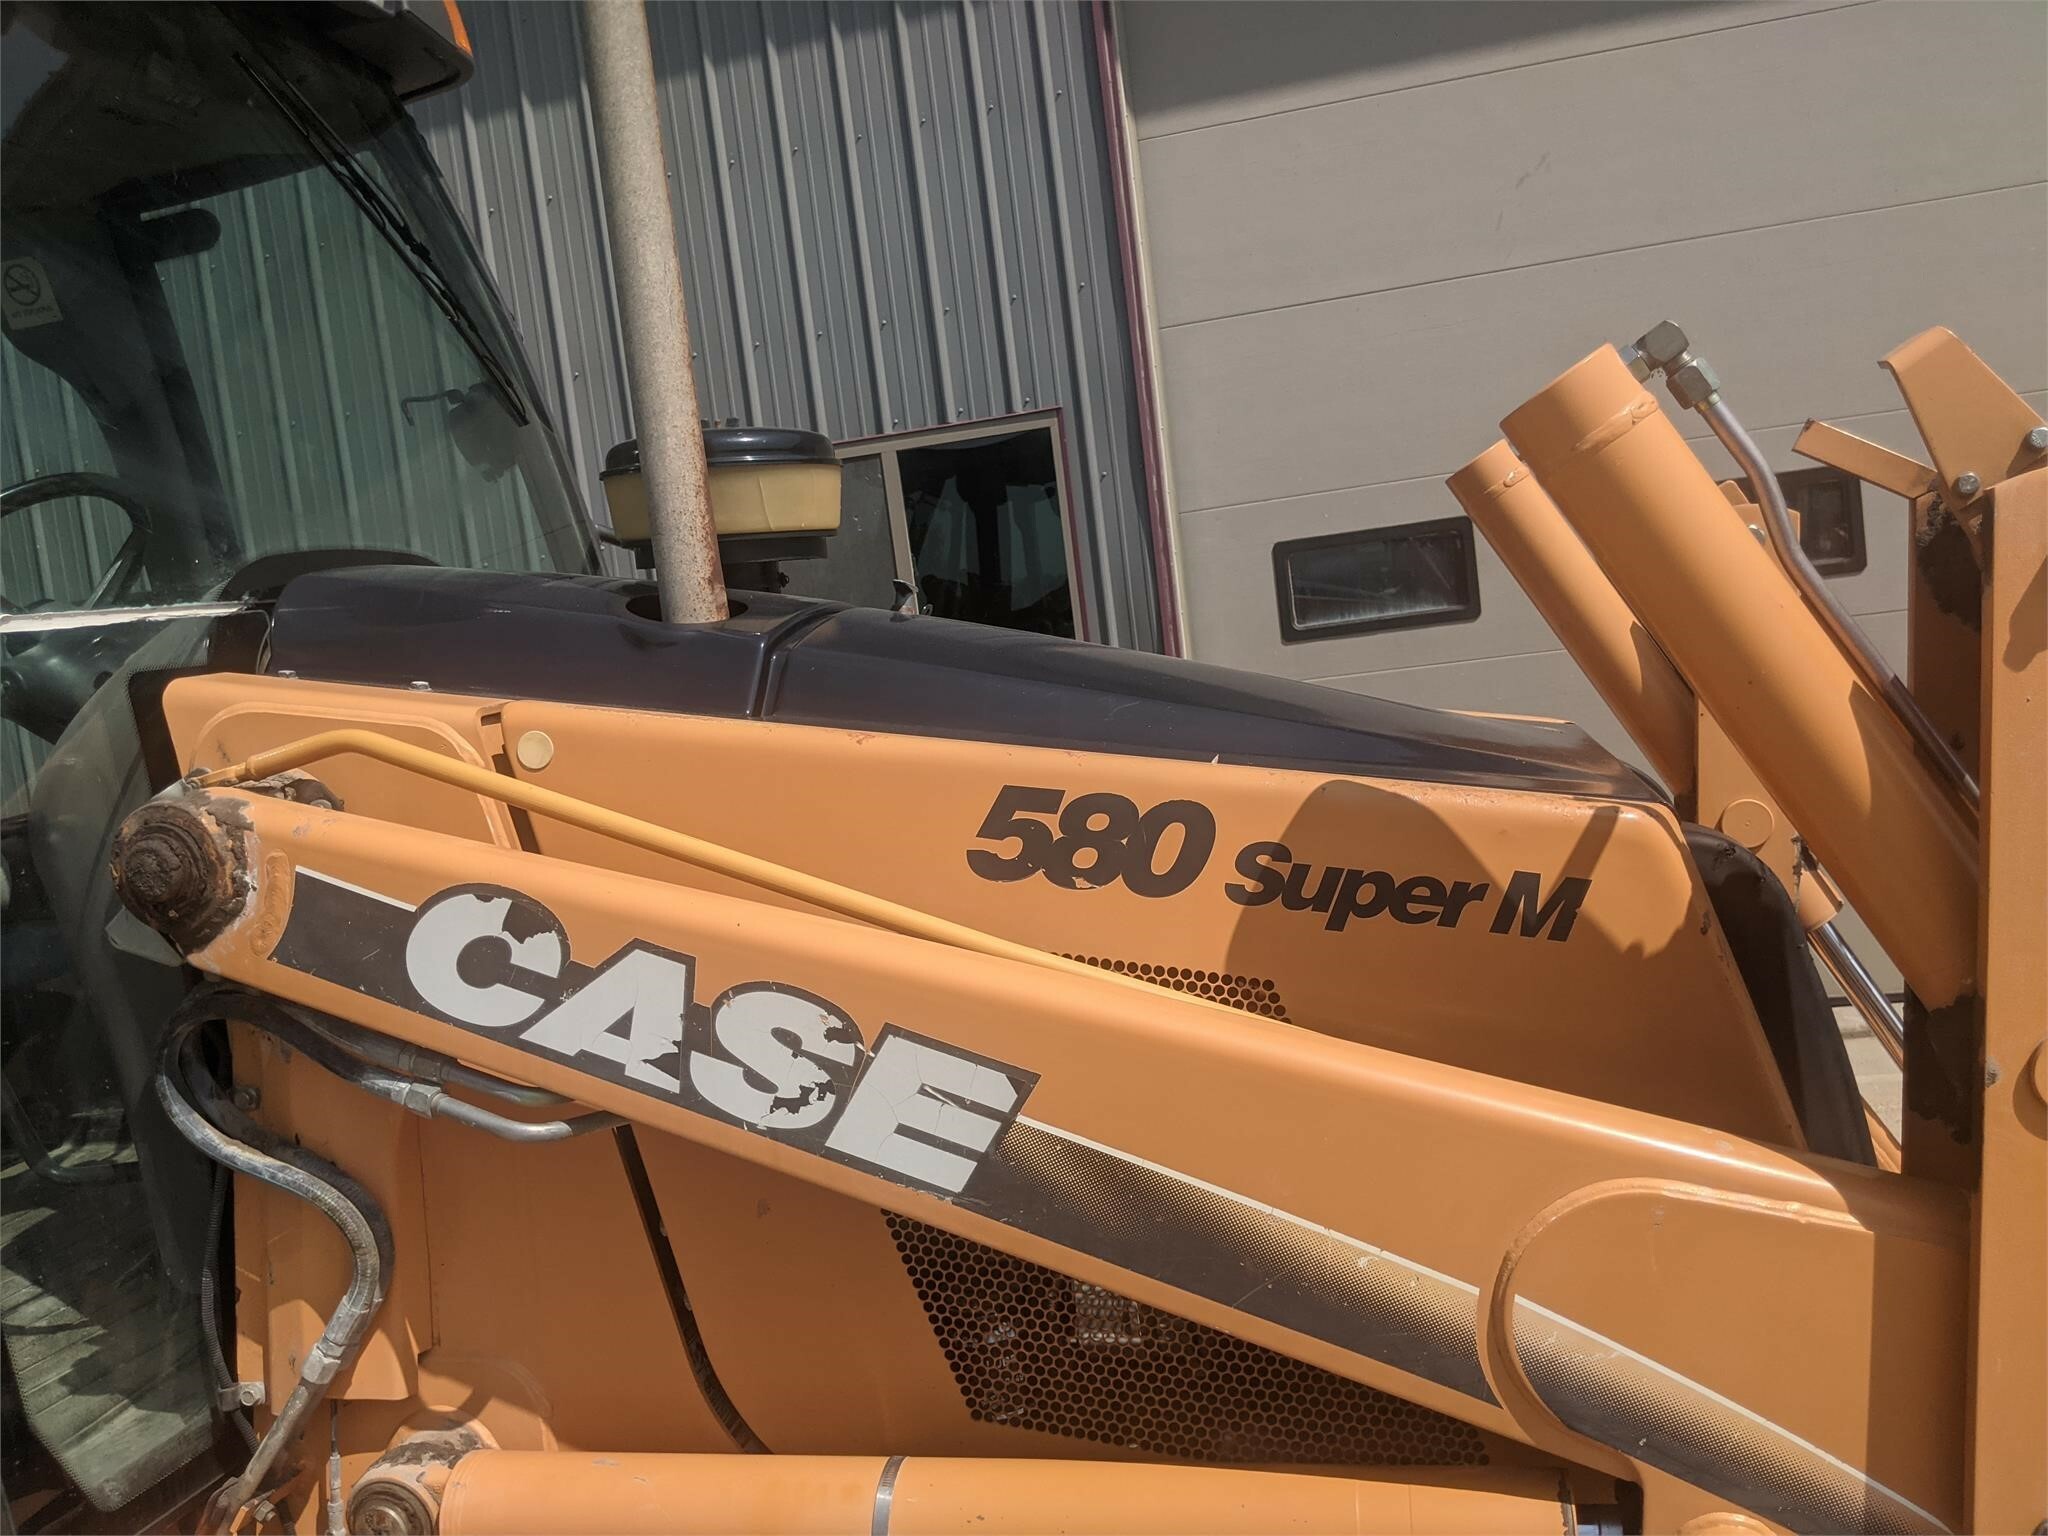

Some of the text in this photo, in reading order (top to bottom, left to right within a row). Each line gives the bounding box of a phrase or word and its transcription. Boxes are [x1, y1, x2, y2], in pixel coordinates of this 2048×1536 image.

[966, 784, 1592, 943] 580 Super M
[405, 892, 1019, 1193] CASE
